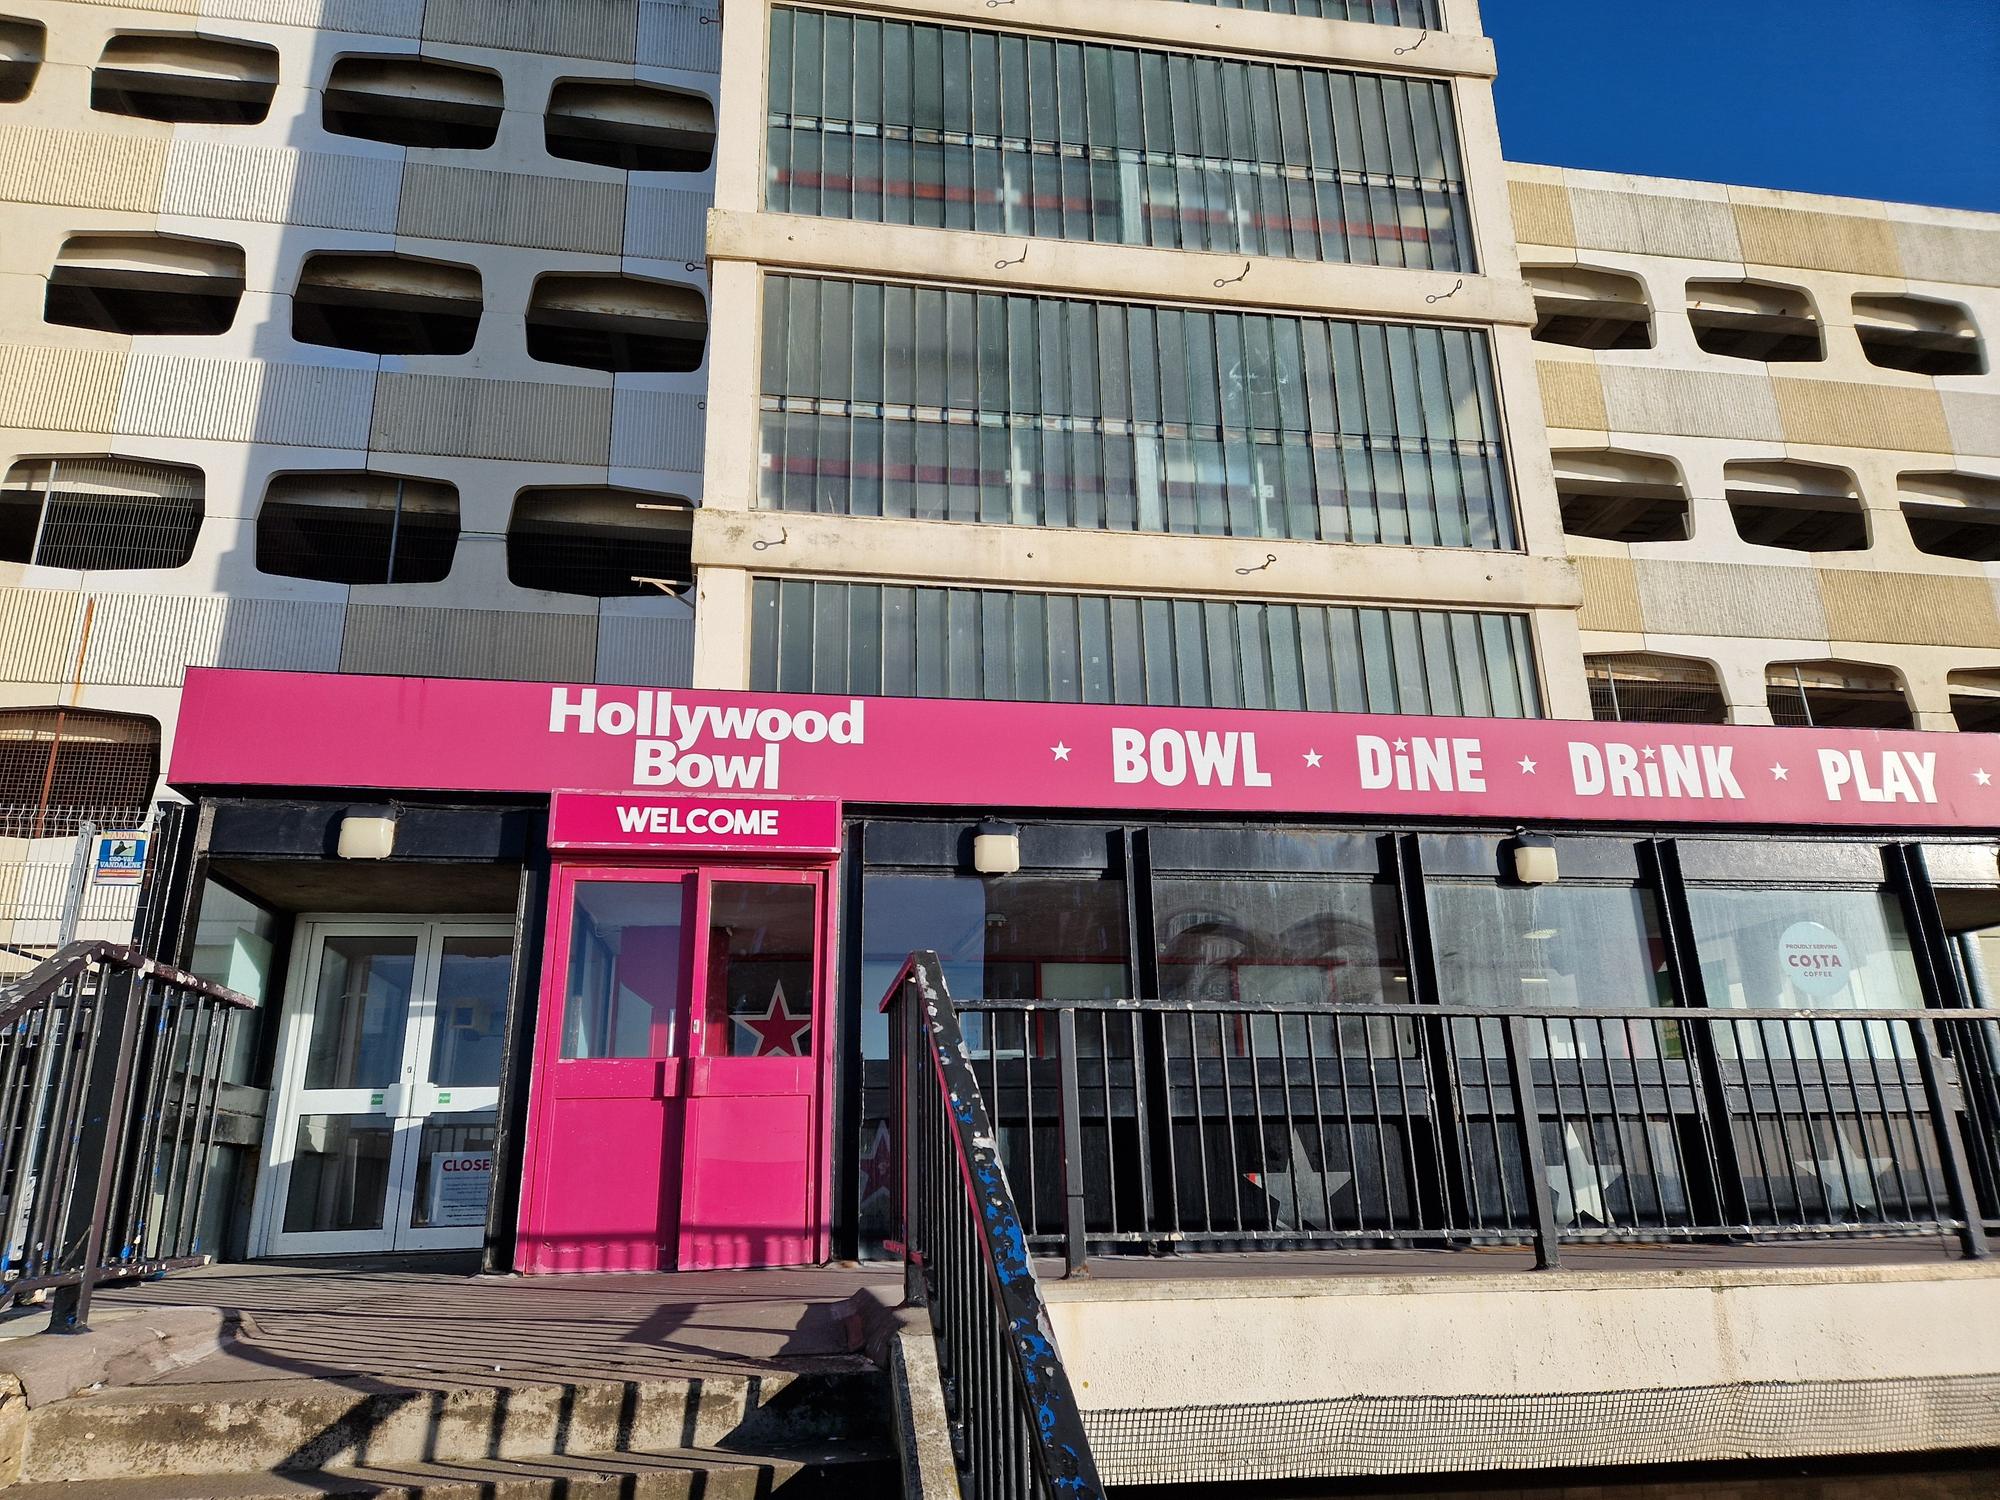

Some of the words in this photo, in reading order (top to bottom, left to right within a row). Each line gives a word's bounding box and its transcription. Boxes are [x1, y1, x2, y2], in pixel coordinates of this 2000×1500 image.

[549, 687, 864, 751] Hollywood
[633, 739, 780, 790] Bowl
[1112, 727, 1272, 787] BOWL
[1817, 748, 1937, 804] PLAY
[616, 806, 779, 836] WELCOME
[1788, 955, 1842, 969] COSTA
[442, 1159, 491, 1171] CLOSE
